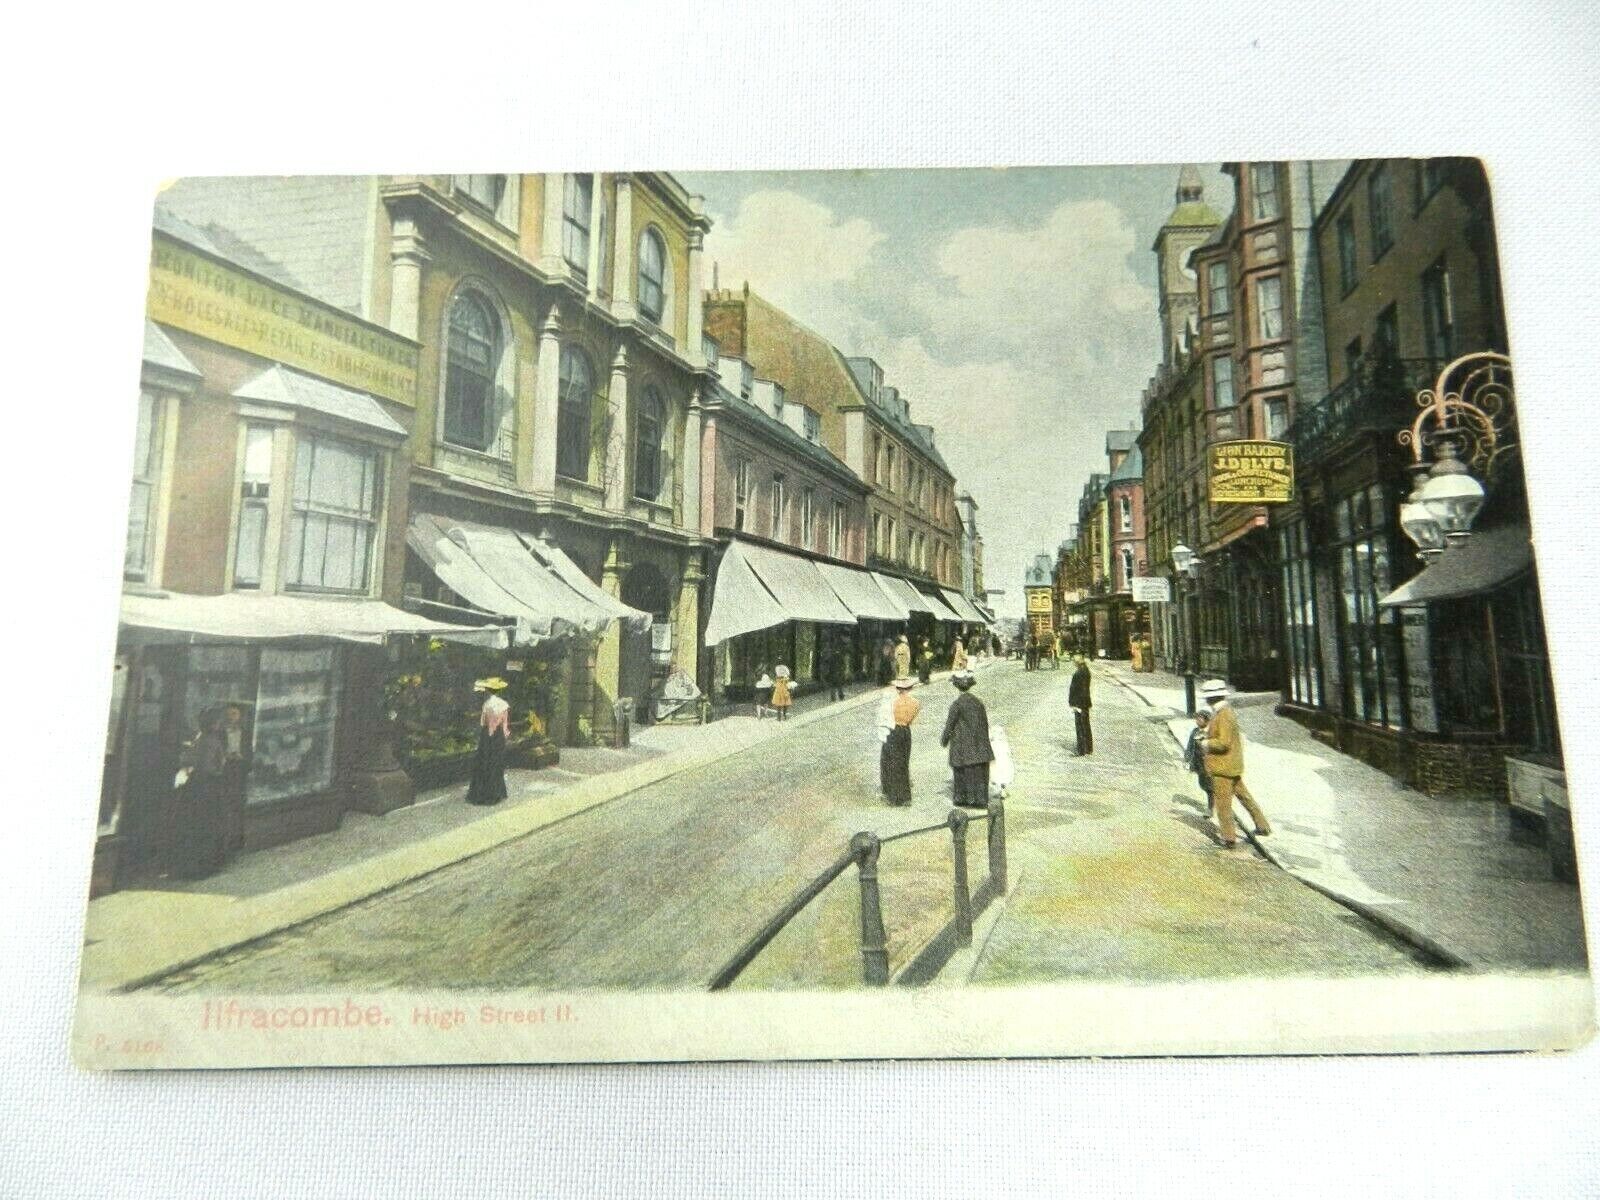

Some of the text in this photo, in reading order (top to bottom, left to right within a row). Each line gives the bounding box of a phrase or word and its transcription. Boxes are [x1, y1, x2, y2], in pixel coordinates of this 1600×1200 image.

[1244, 444, 1286, 456] BAKERY
[201, 997, 391, 1030] Ilfracombe.
[411, 1006, 466, 1031] High
[480, 1004, 546, 1024] Street
